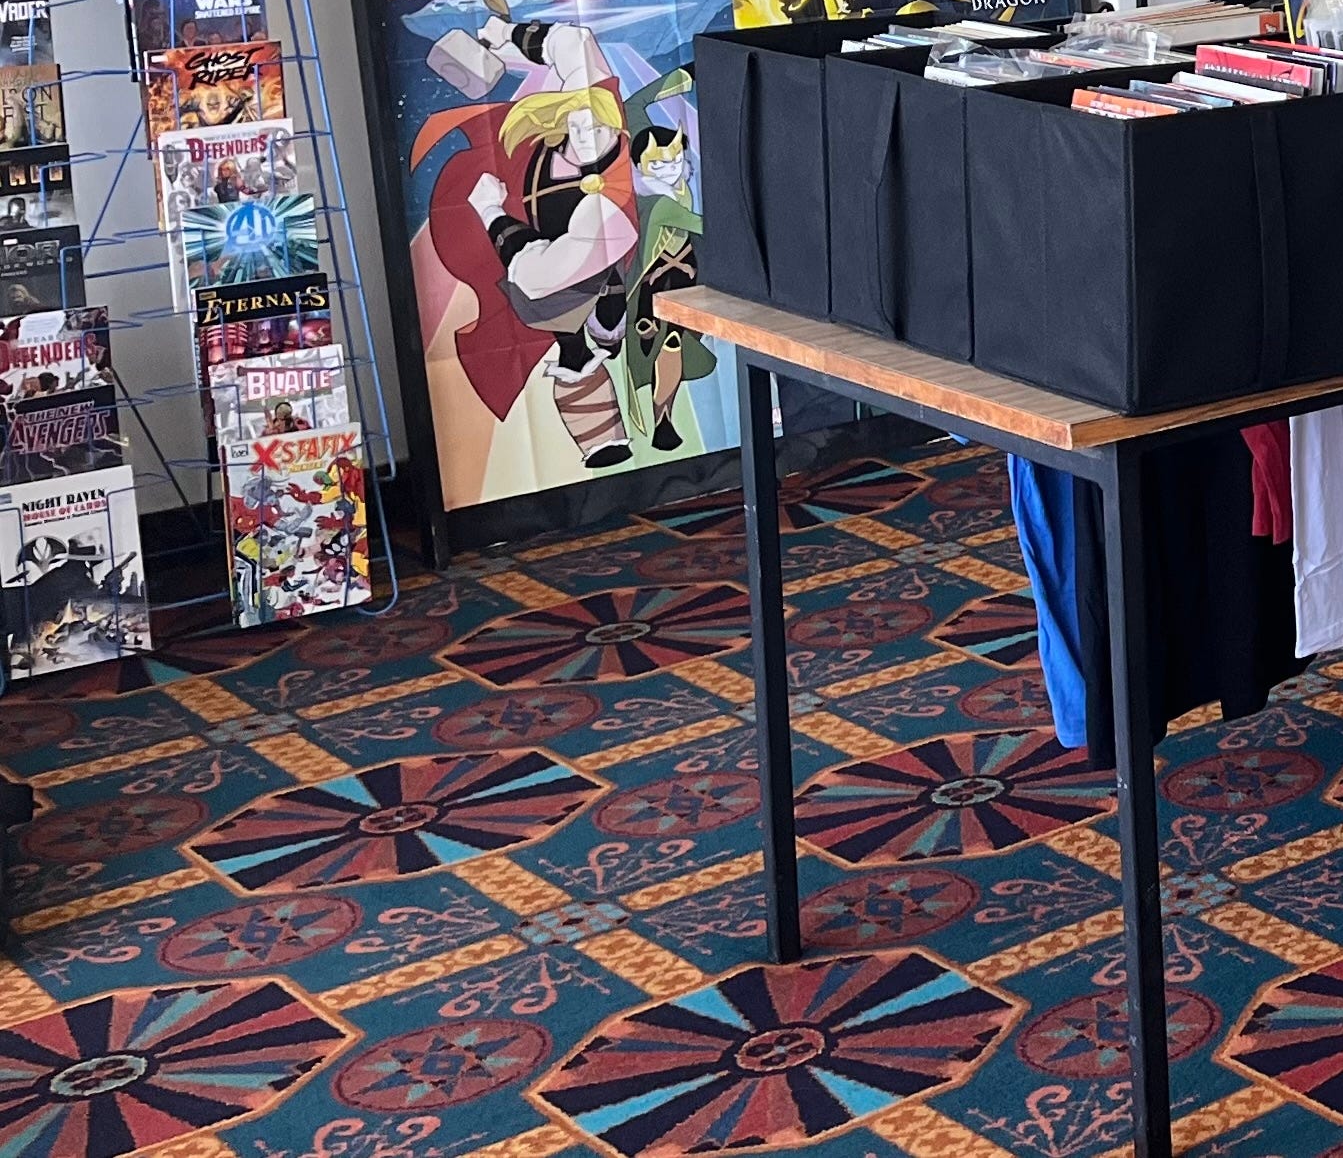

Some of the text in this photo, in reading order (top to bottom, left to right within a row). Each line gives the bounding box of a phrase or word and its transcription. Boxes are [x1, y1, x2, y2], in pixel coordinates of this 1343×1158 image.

[185, 46, 264, 71] GHOST
[188, 66, 261, 90] RIDER
[186, 133, 269, 163] DEFENDERS
[247, 370, 331, 401] BLADE
[26, 400, 95, 424] THE NEW
[6, 409, 110, 454] AVENGERS
[22, 488, 105, 512] NIGHT RAVEN
